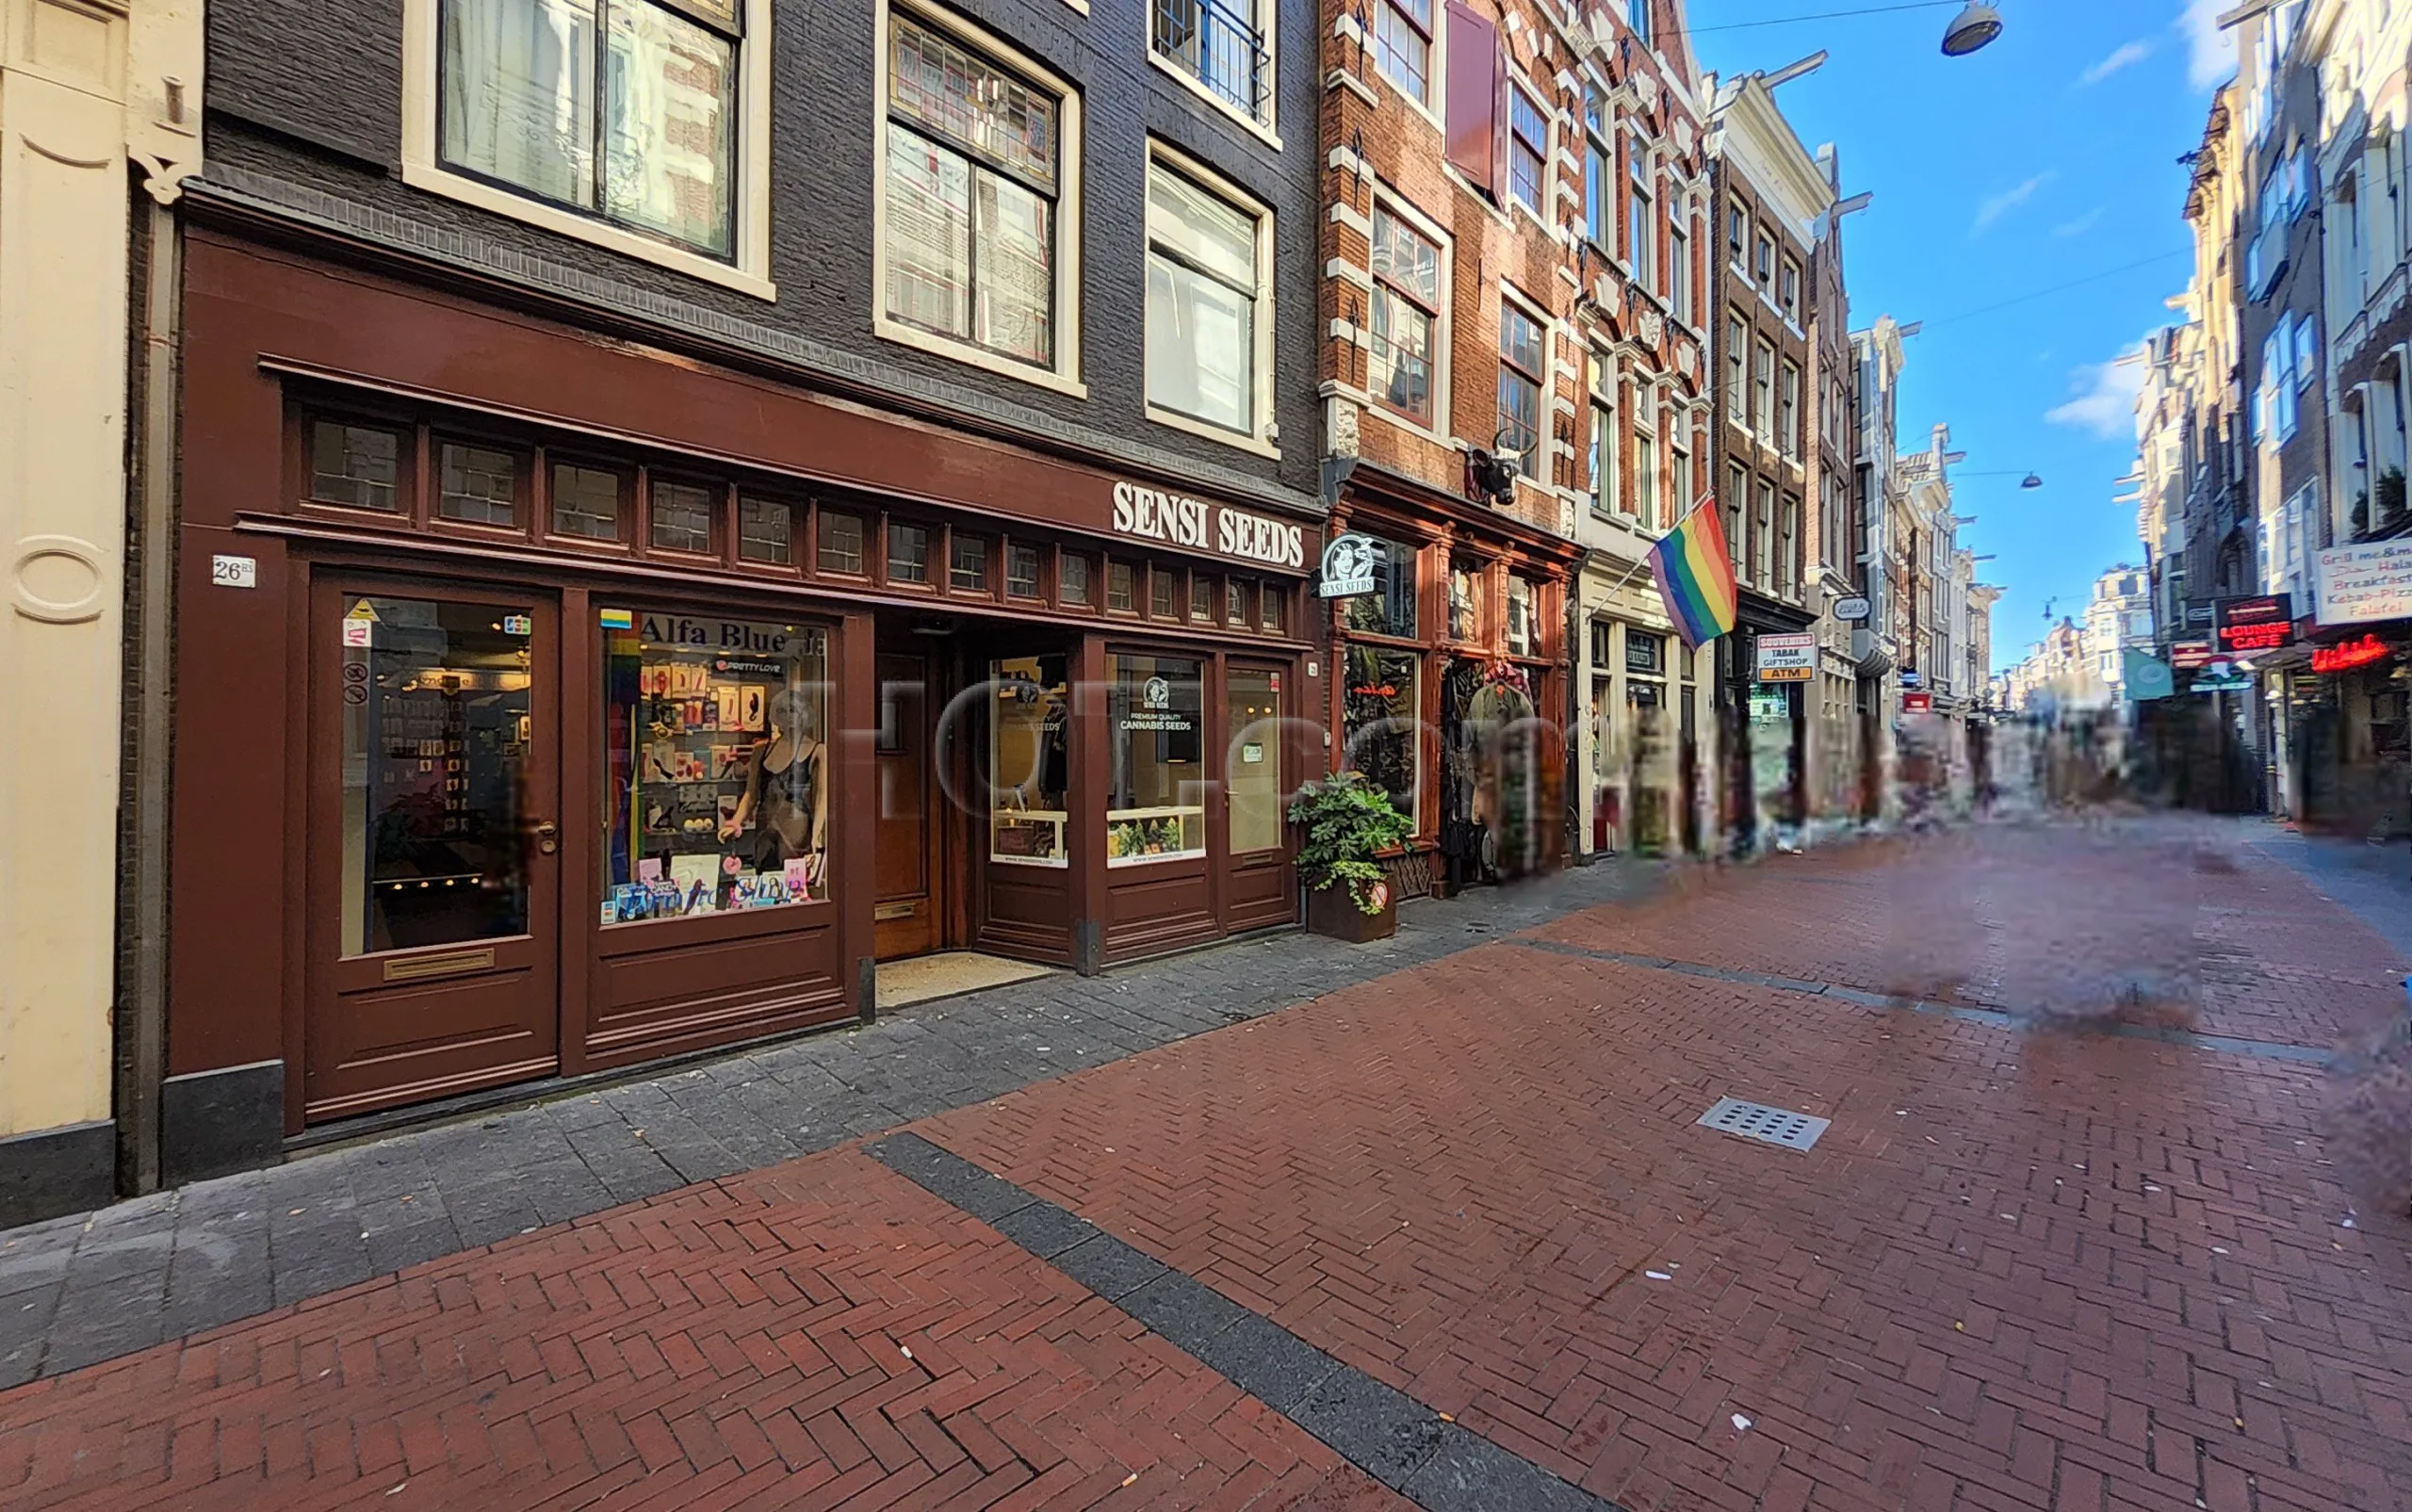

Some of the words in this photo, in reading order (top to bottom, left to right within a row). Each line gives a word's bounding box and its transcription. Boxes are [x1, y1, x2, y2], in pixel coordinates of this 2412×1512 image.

[1114, 481, 1209, 548] SENSI
[1218, 508, 1304, 567] SEEDS
[1321, 583, 1343, 596] SENSI
[1346, 579, 1372, 592] SEEDS
[641, 616, 707, 644] Alfa
[719, 623, 786, 652] Blue
[2220, 621, 2291, 638] LOUNGE
[2232, 634, 2283, 649] CAFE
[1771, 648, 1801, 658] TABAK
[1763, 658, 1808, 667] GIFTSHOP
[1771, 668, 1801, 677] ATM
[1120, 721, 1165, 730] CANNABIS
[1165, 722, 1192, 730] SEEDS
